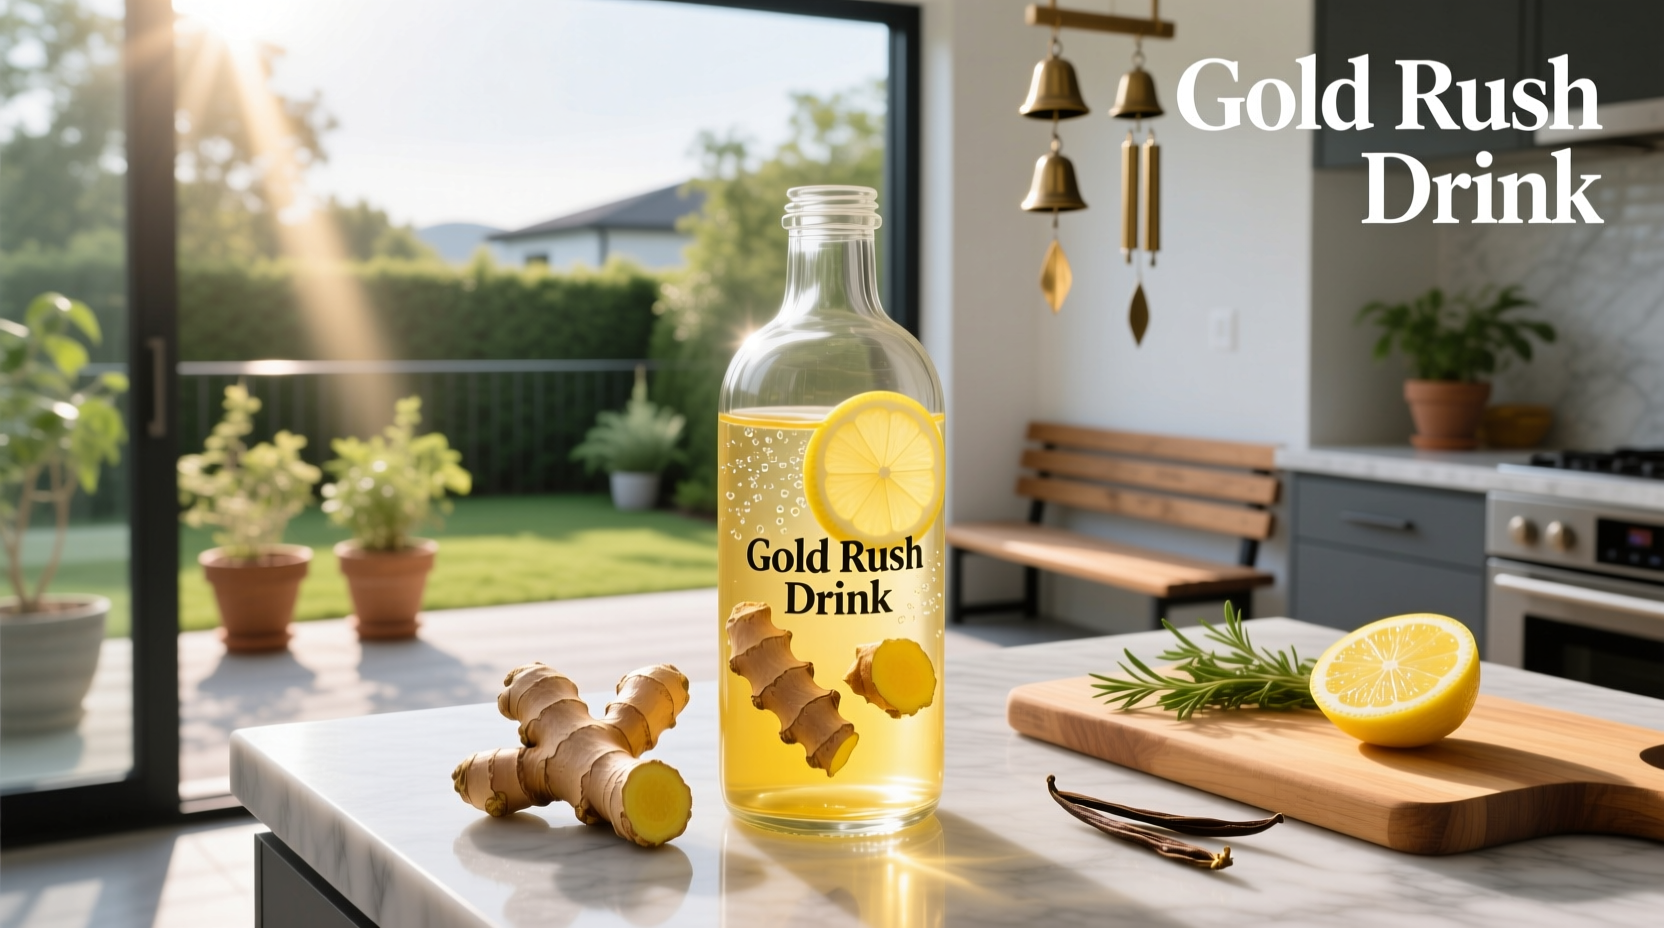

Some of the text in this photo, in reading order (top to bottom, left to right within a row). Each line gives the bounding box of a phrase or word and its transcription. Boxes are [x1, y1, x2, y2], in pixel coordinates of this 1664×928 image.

[746, 535, 924, 573] Gold Rush
[784, 579, 893, 615] Drink
